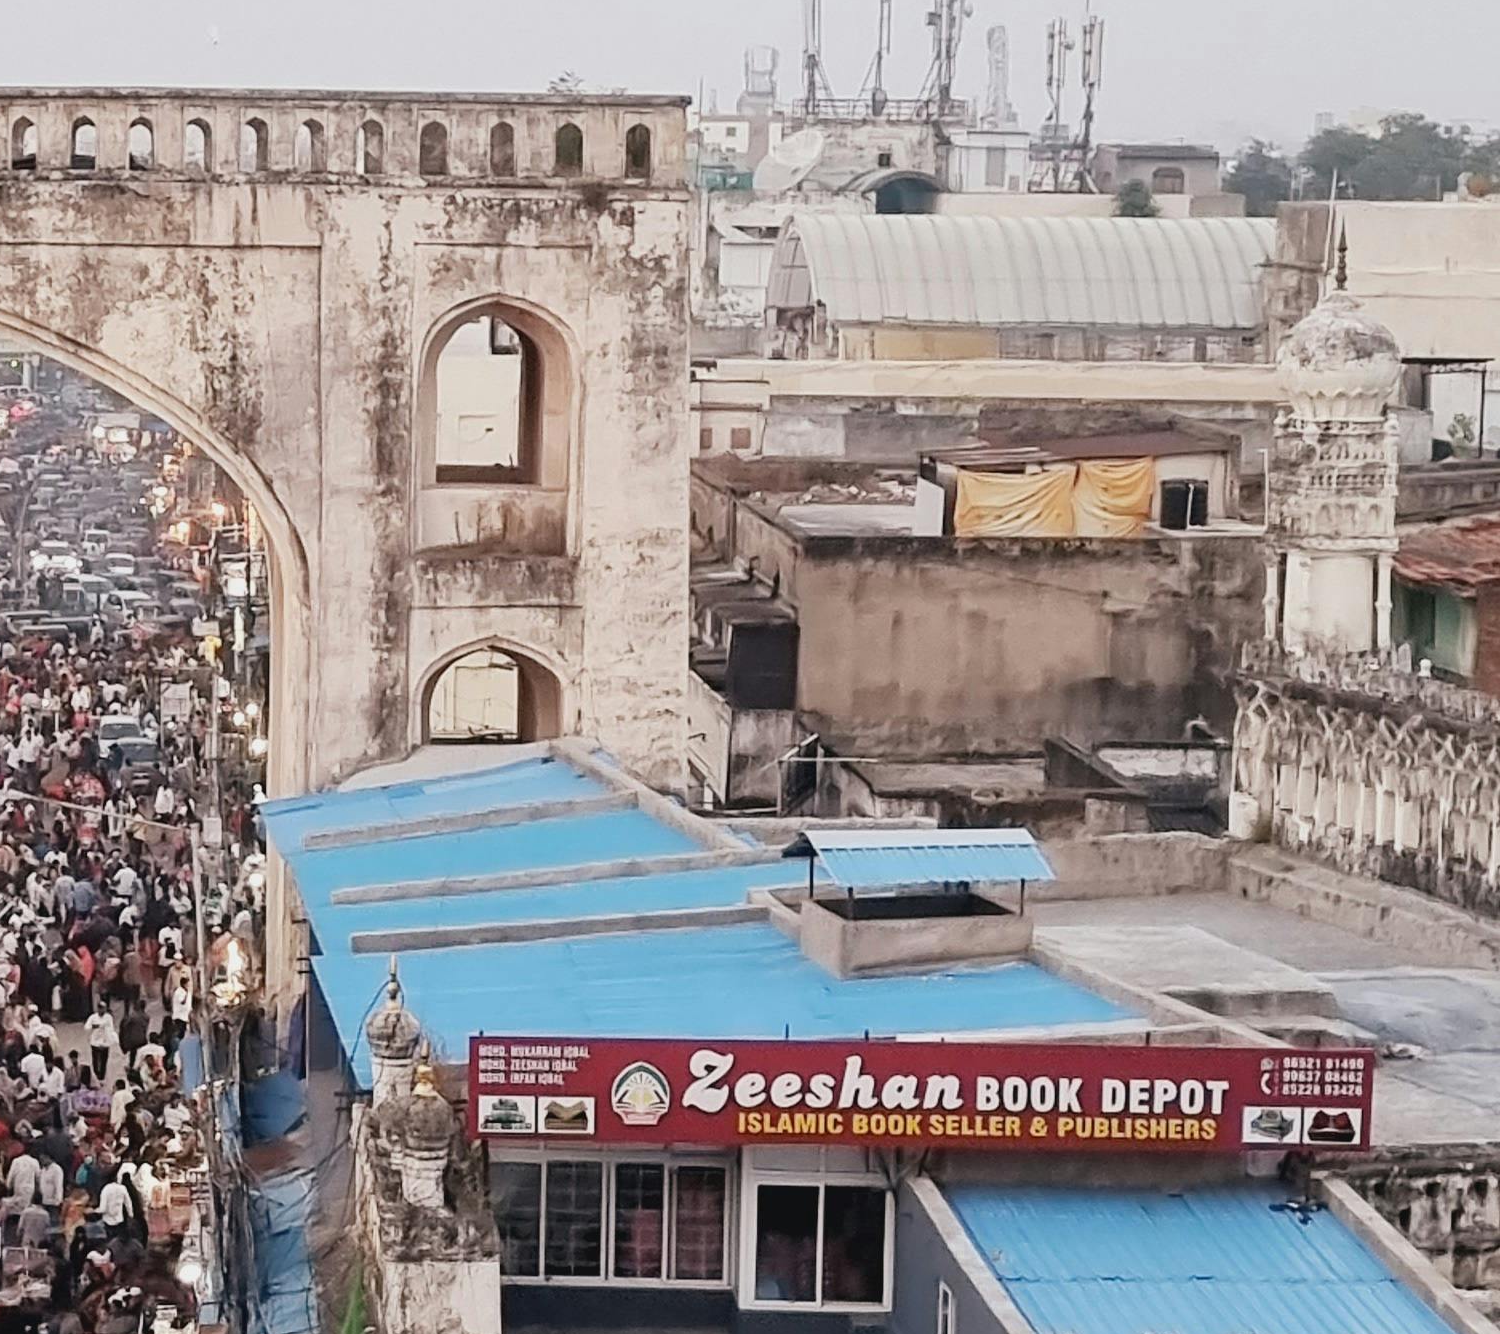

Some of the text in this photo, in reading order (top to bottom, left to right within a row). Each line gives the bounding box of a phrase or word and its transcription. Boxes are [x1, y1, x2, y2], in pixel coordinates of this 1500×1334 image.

[682, 1049, 1230, 1115] Zeeshan BOOK DEPOT
[738, 1112, 1218, 1140] ISLAMIC BOOK SELLER & PUBLISHERS
